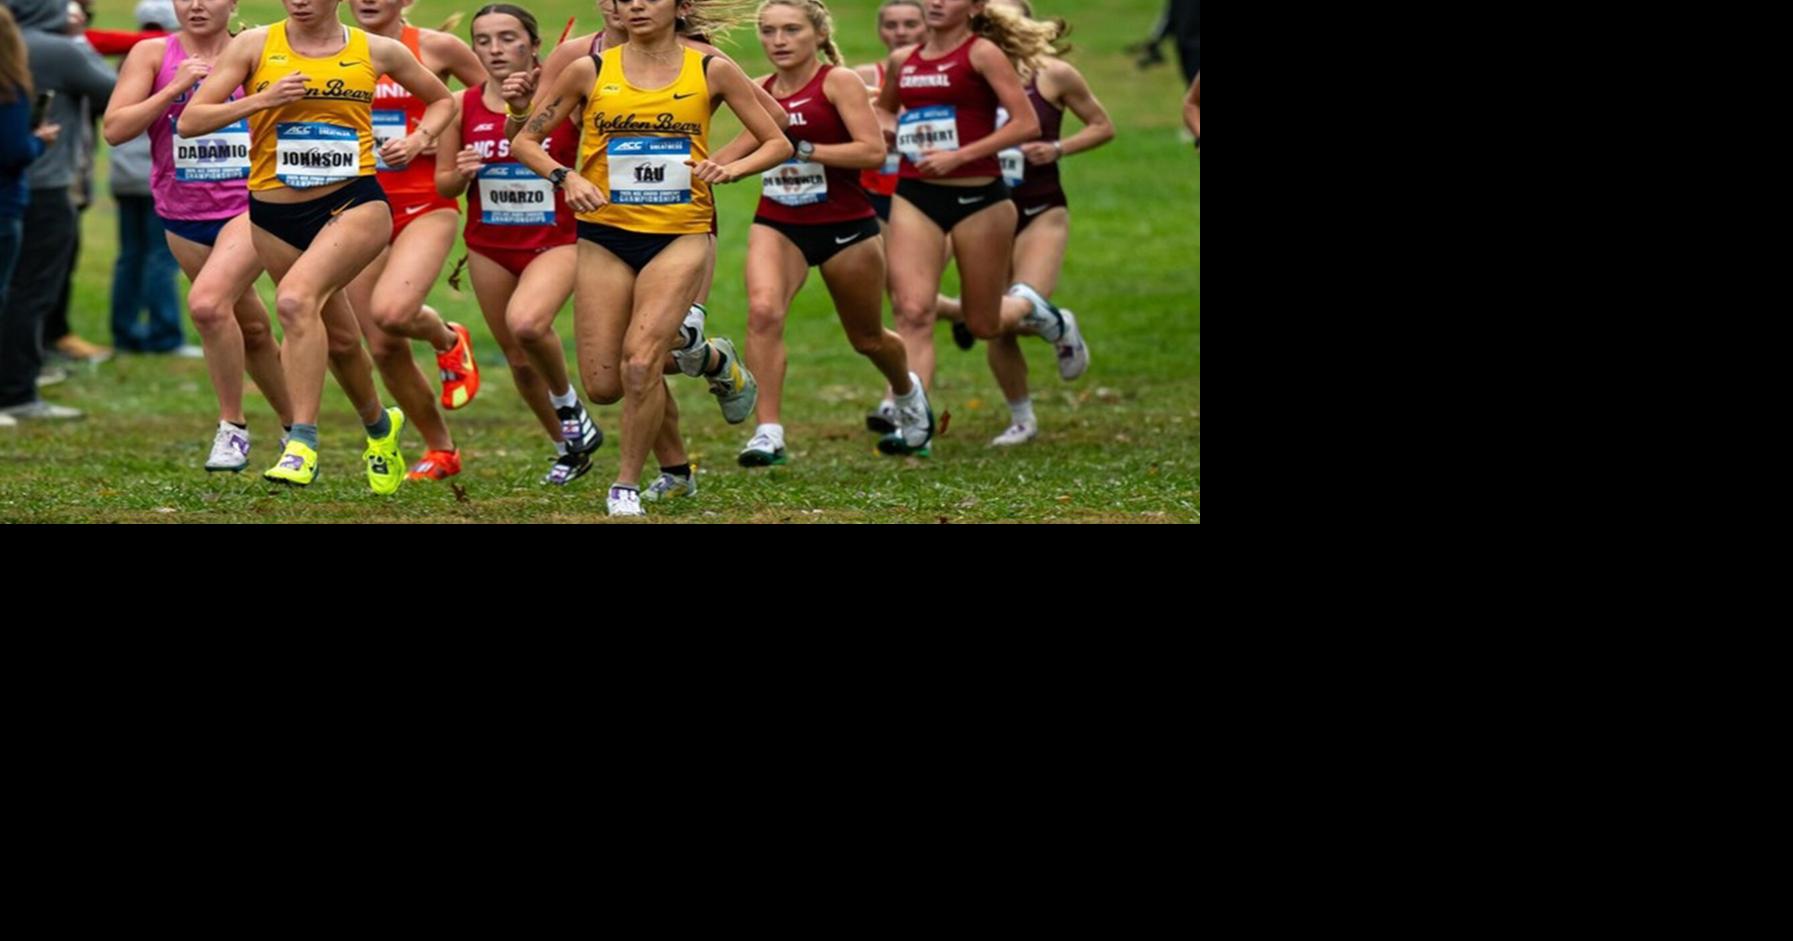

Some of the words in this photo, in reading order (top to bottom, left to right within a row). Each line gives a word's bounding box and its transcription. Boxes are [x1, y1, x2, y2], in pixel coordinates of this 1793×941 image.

[900, 74, 951, 88] CARDINAL
[283, 126, 312, 135] ACC
[593, 112, 651, 135] Golden
[178, 145, 247, 159] DADAMIO
[474, 140, 494, 158] NC
[613, 141, 643, 151] ACC
[282, 152, 353, 167] JOHNSON
[484, 167, 509, 176] ACC
[635, 167, 664, 182] TAU
[490, 190, 544, 204] QUARZO
